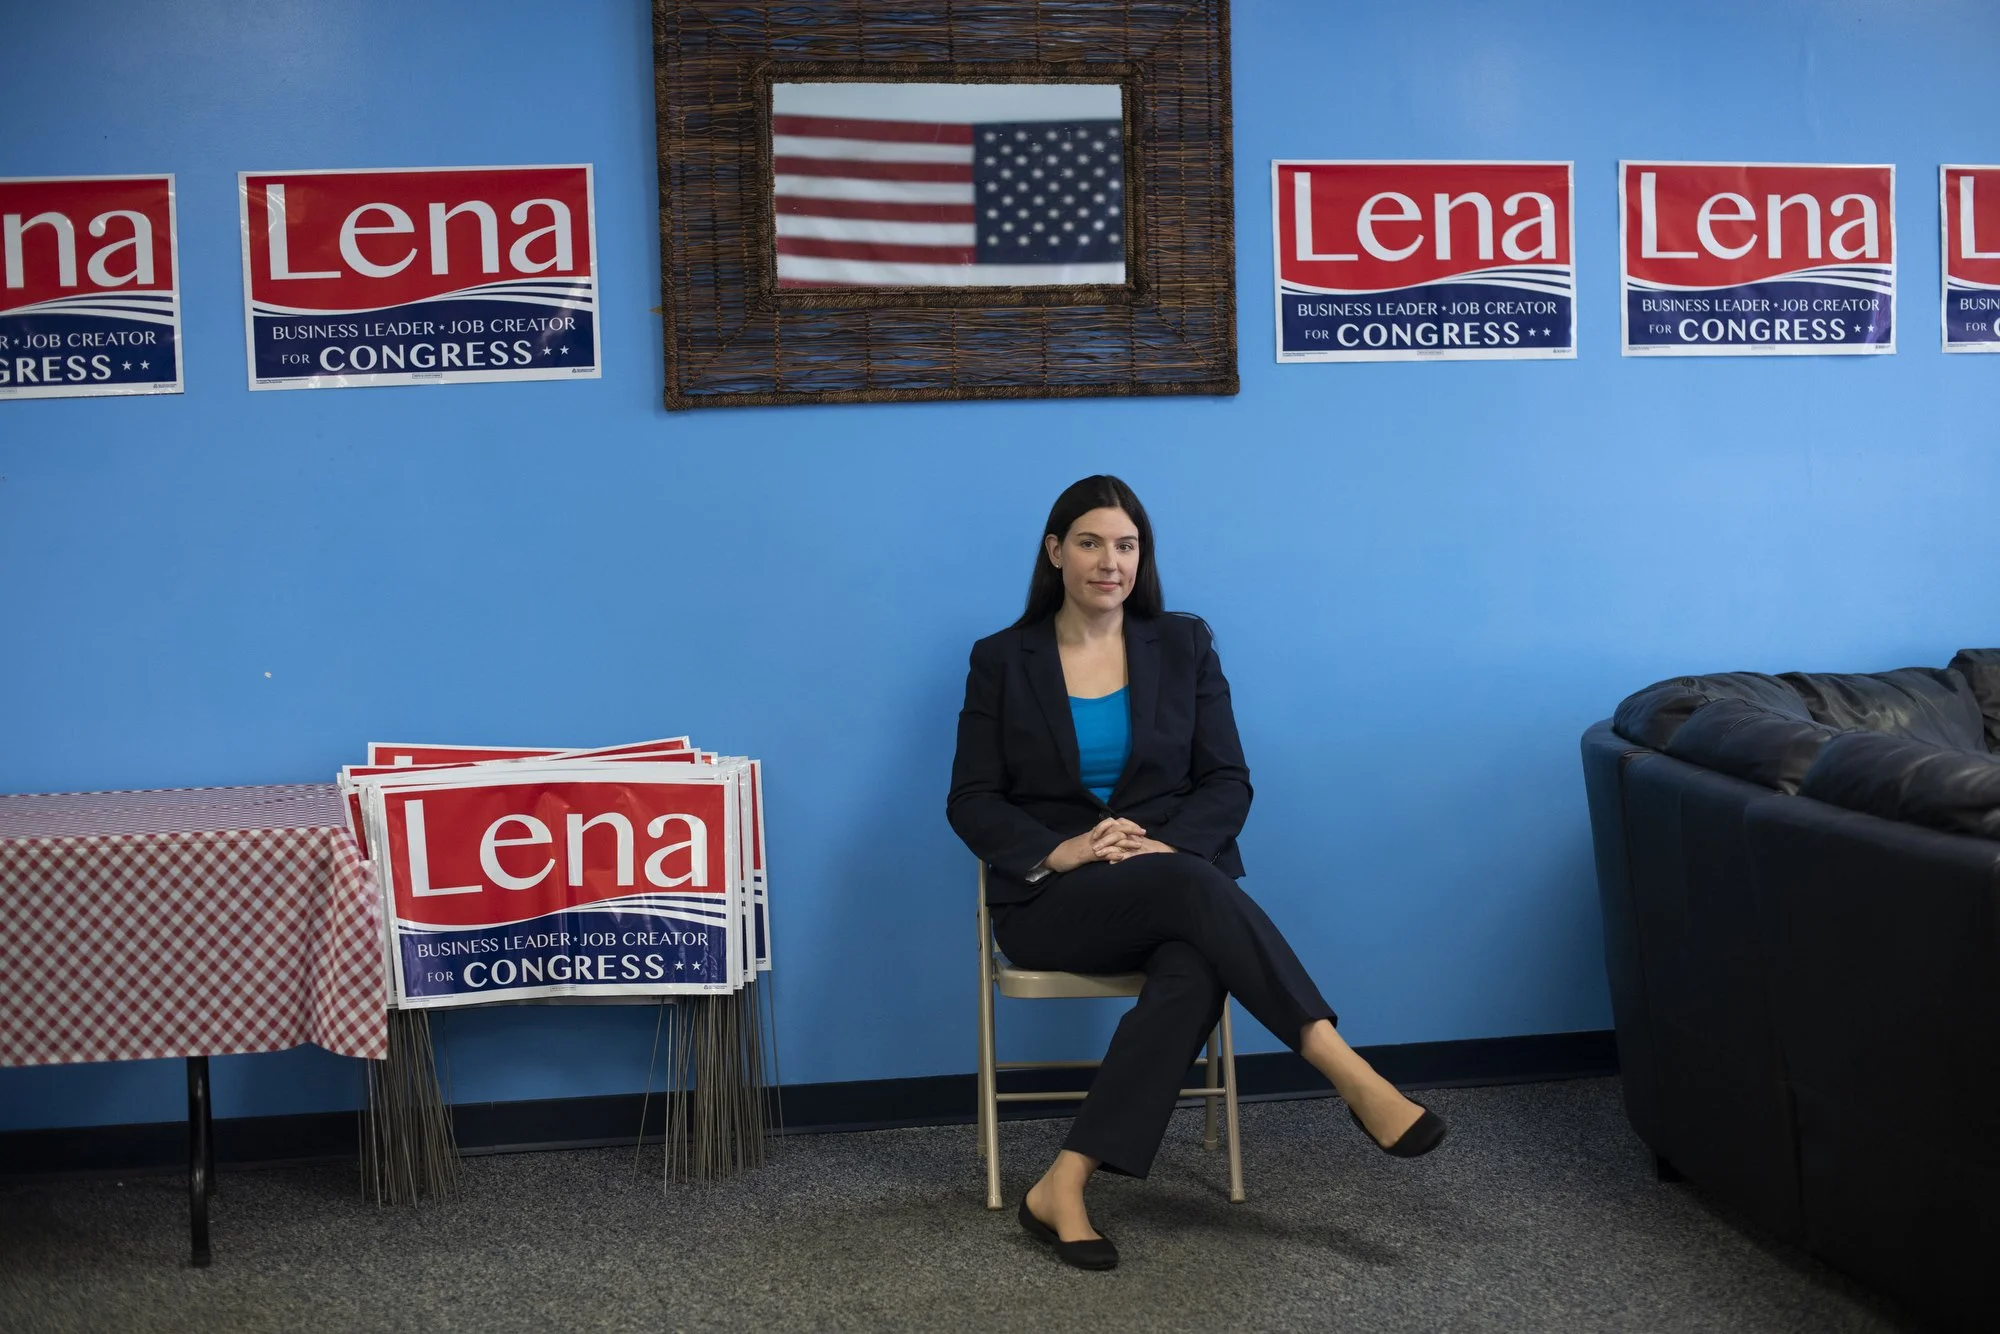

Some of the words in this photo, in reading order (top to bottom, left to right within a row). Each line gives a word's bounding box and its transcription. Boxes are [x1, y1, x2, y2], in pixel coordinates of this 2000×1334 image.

[1295, 172, 1556, 261] Lena
[1641, 173, 1879, 260] Lena
[266, 184, 574, 280] Lena
[1297, 302, 1372, 317] BUSINESS
[1377, 302, 1438, 316] LEADER
[1449, 301, 1480, 315] JOB
[1484, 301, 1557, 315] CREATOR
[1642, 299, 1710, 312] BUSINESS
[1715, 299, 1771, 312] LEADER
[1780, 299, 1809, 312] JOB
[1812, 298, 1880, 312] CREATOR
[23, 334, 61, 349] JOB
[67, 330, 156, 347] CREATOR
[272, 323, 359, 340] BUSINESS
[365, 321, 435, 337] LEADER
[448, 319, 485, 334] JOB
[490, 316, 576, 333] CREATOR
[1305, 329, 1329, 340] FOR
[1337, 321, 1520, 346] CONGRESS
[1649, 324, 1672, 334] FOR
[1679, 319, 1845, 341] CONGRESS
[1965, 322, 1987, 332] FOR
[281, 353, 310, 365] FOR
[319, 340, 532, 371] CONGRESS
[404, 800, 708, 898] Lena
[417, 937, 499, 958] BUSINESS
[504, 932, 571, 951] LEADER
[579, 932, 617, 947] JOB
[622, 931, 709, 946] CREATOR
[427, 971, 454, 983] FOR
[463, 954, 664, 987] CONGRESS
